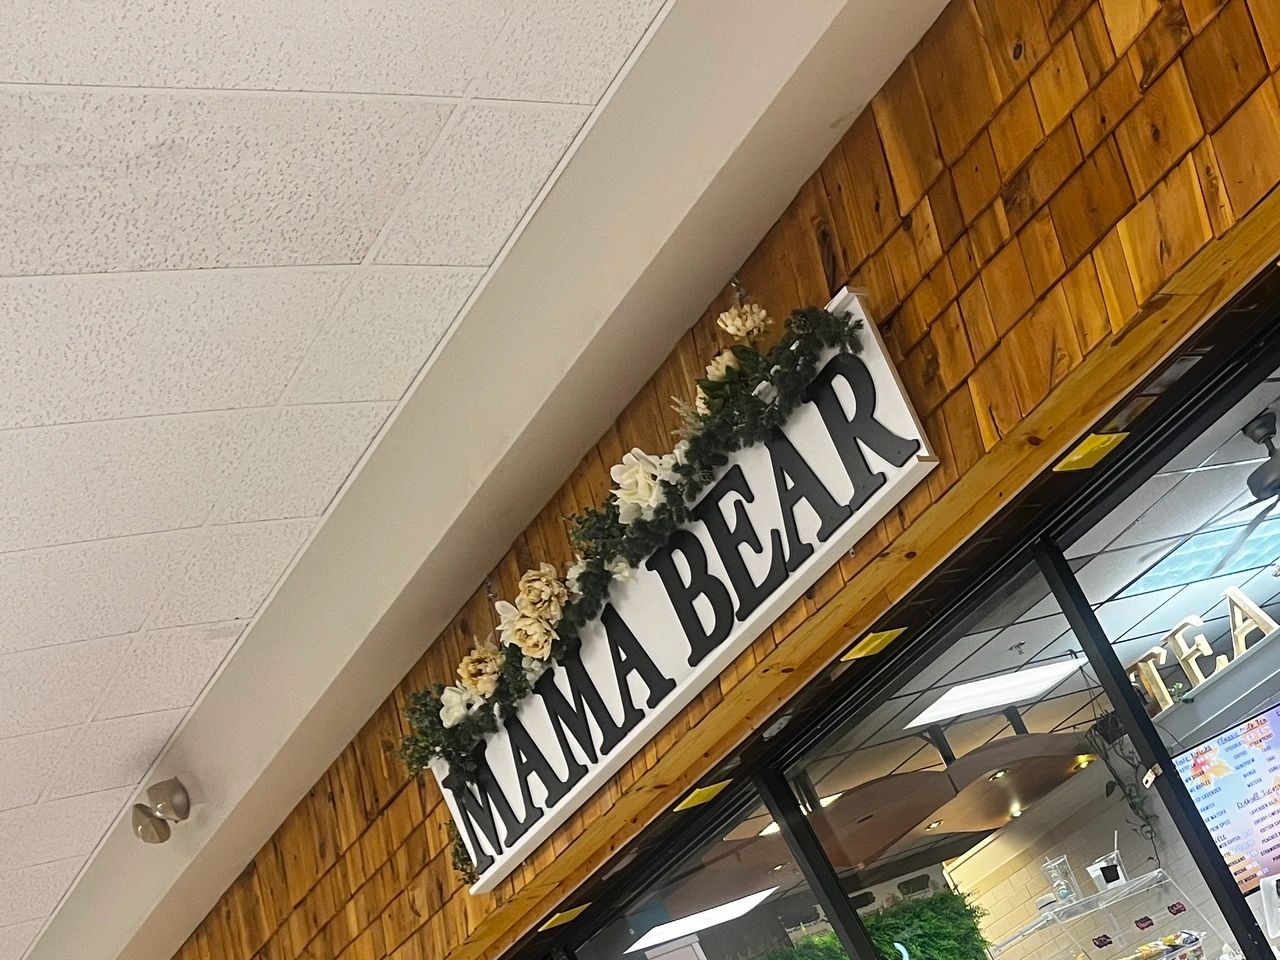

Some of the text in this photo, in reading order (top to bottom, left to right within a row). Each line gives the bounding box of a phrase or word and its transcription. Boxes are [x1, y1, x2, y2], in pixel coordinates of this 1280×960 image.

[443, 352, 921, 875] MAMA BEAR
[1125, 586, 1280, 713] TEA
